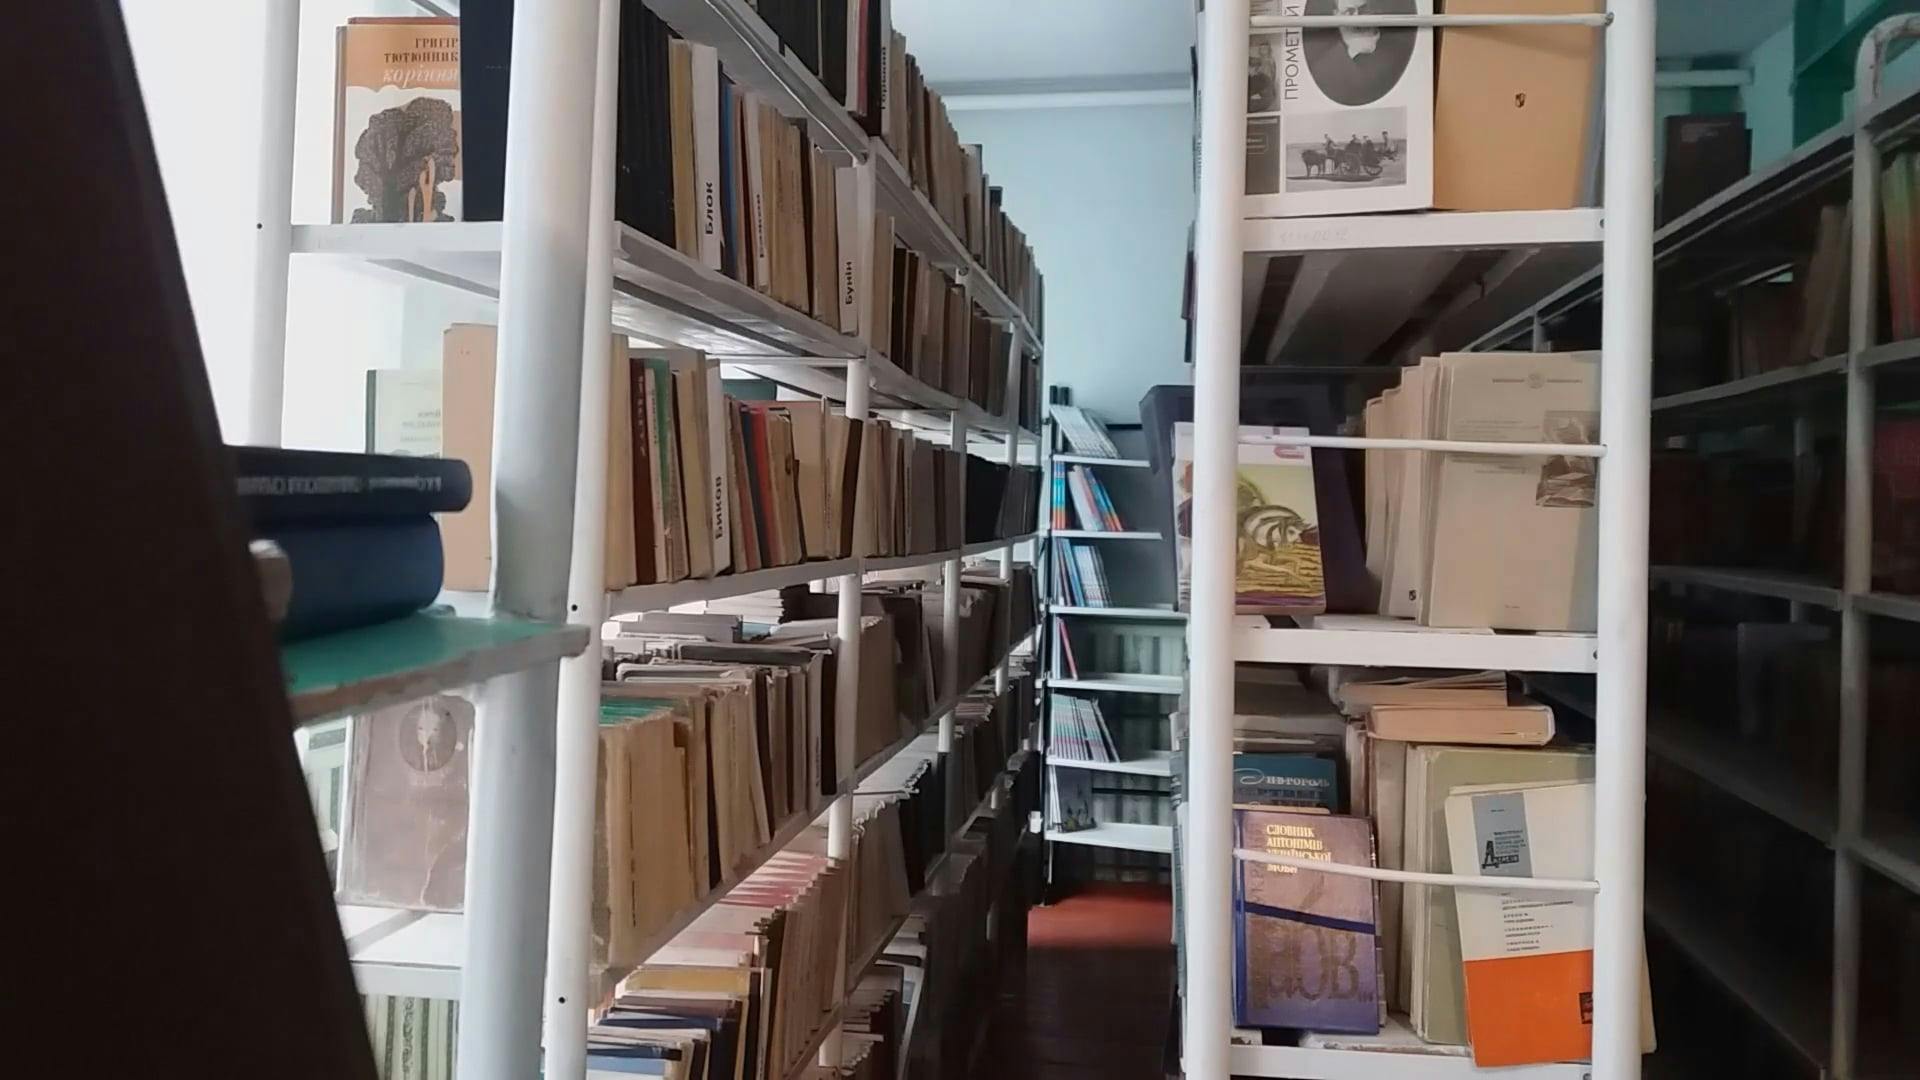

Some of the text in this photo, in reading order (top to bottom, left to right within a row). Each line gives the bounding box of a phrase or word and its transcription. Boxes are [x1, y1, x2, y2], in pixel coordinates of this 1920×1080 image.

[415, 37, 458, 49] ГРИГІР
[384, 52, 458, 63] ТЮТЮННИК
[1283, 5, 1300, 100] ПРОМЕТЙ
[1266, 824, 1315, 838] СЛОВНИК
[1266, 837, 1323, 851] АНТОНІМІВ
